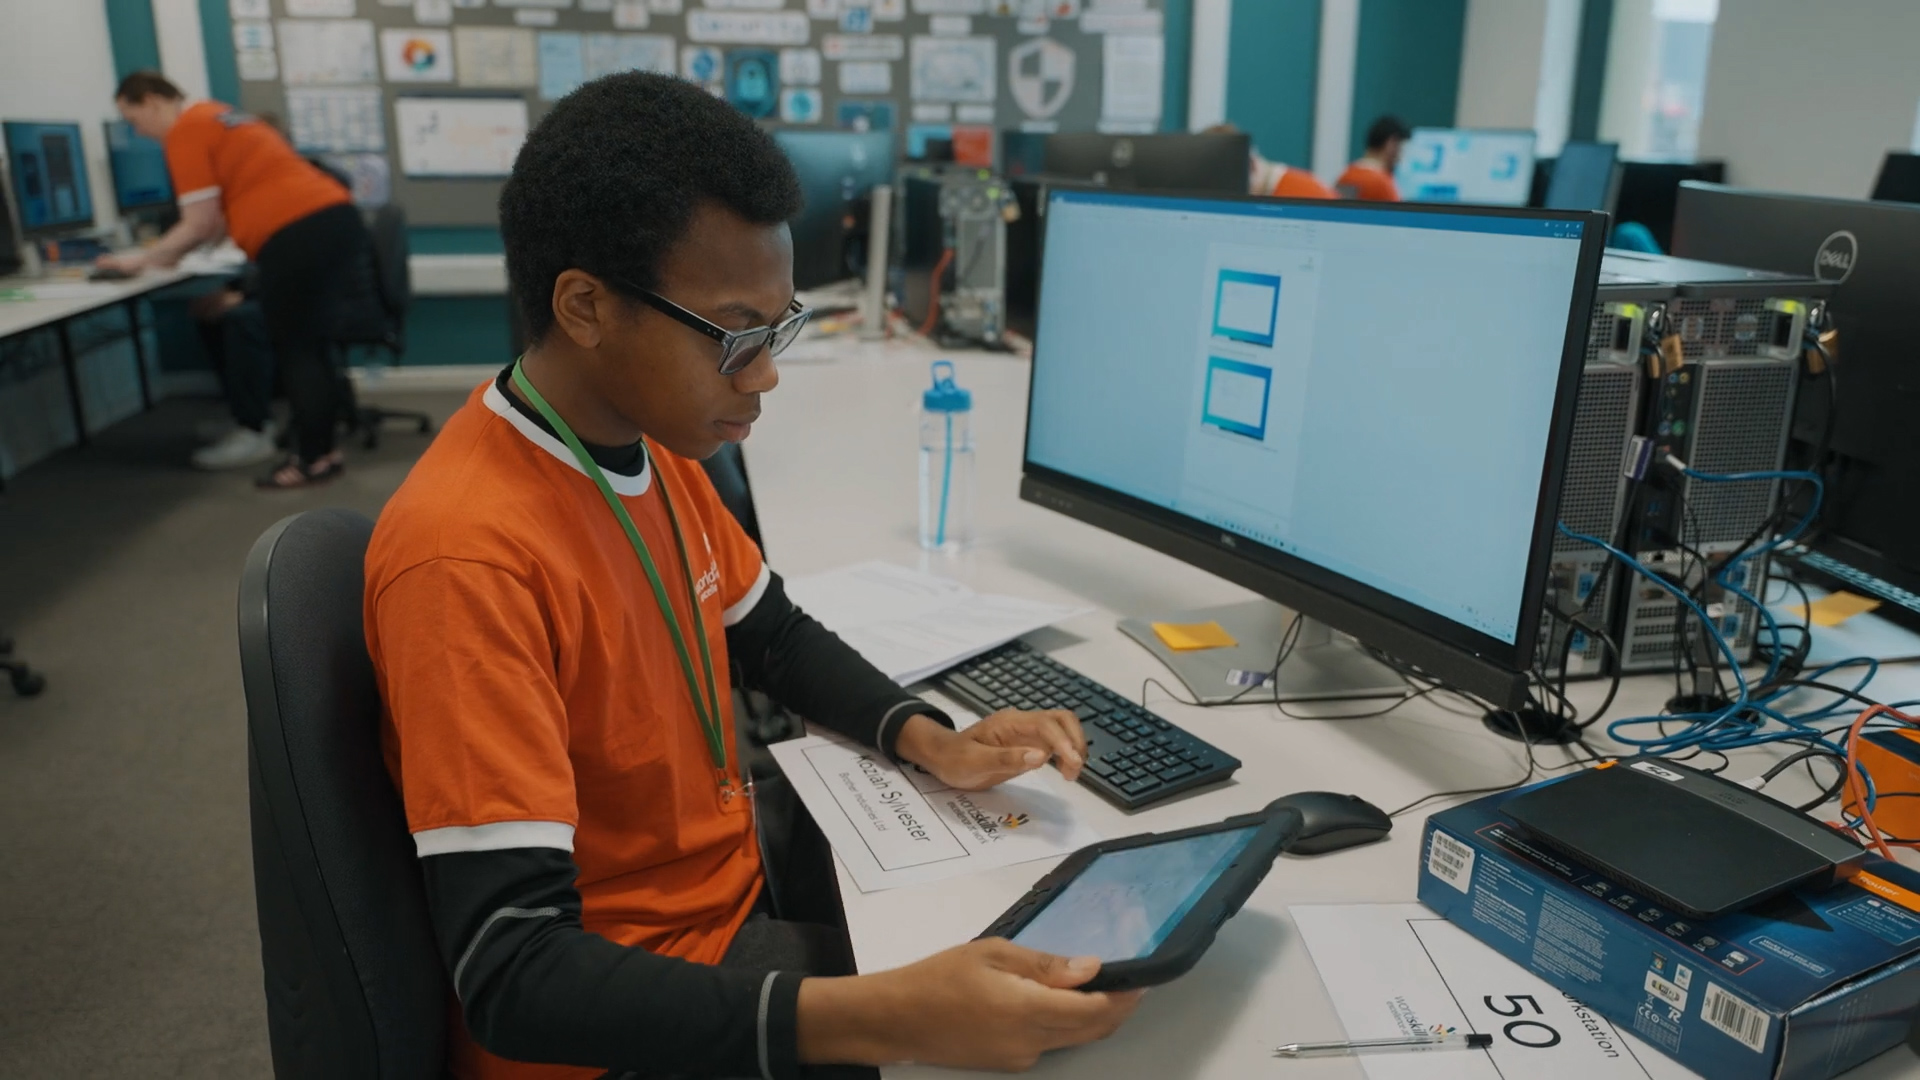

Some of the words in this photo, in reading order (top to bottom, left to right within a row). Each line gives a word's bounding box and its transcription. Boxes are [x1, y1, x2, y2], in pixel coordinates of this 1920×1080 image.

[852, 754, 892, 790] Koziah
[839, 772, 858, 793] Brother
[854, 792, 878, 820] Industries
[873, 820, 890, 832] Ltd
[879, 790, 932, 842] Sylvester
[1859, 876, 1899, 896] Router
[1483, 995, 1561, 1048] 50
[1560, 990, 1620, 1058] orkstation
